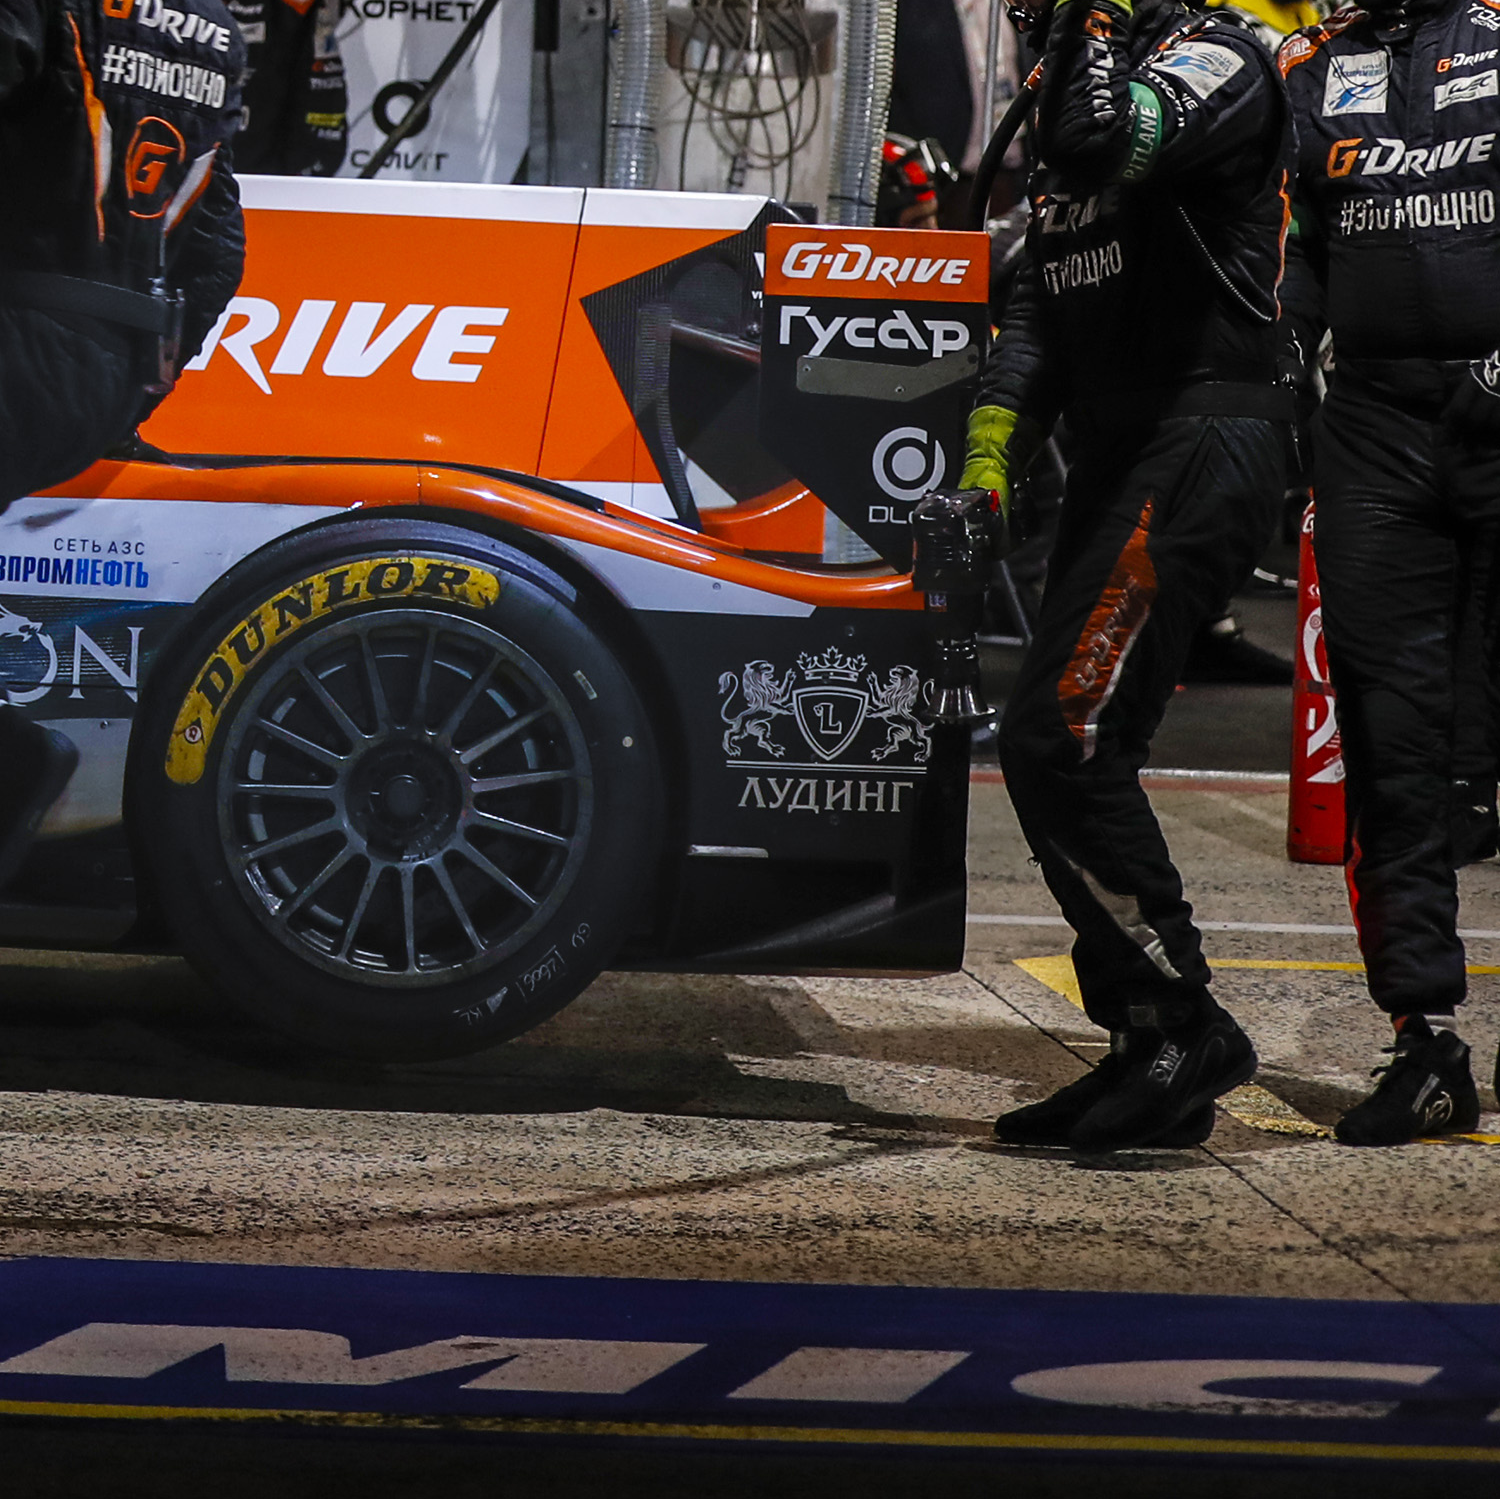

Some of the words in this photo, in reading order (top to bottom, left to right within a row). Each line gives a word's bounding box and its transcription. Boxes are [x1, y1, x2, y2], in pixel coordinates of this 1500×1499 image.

[1122, 104, 1159, 181] PITLANE
[53, 537, 103, 555] СЕТЬ
[107, 540, 147, 557] АЗС
[194, 559, 473, 721] DUNLOP
[737, 776, 915, 814] ЛУДИНГ
